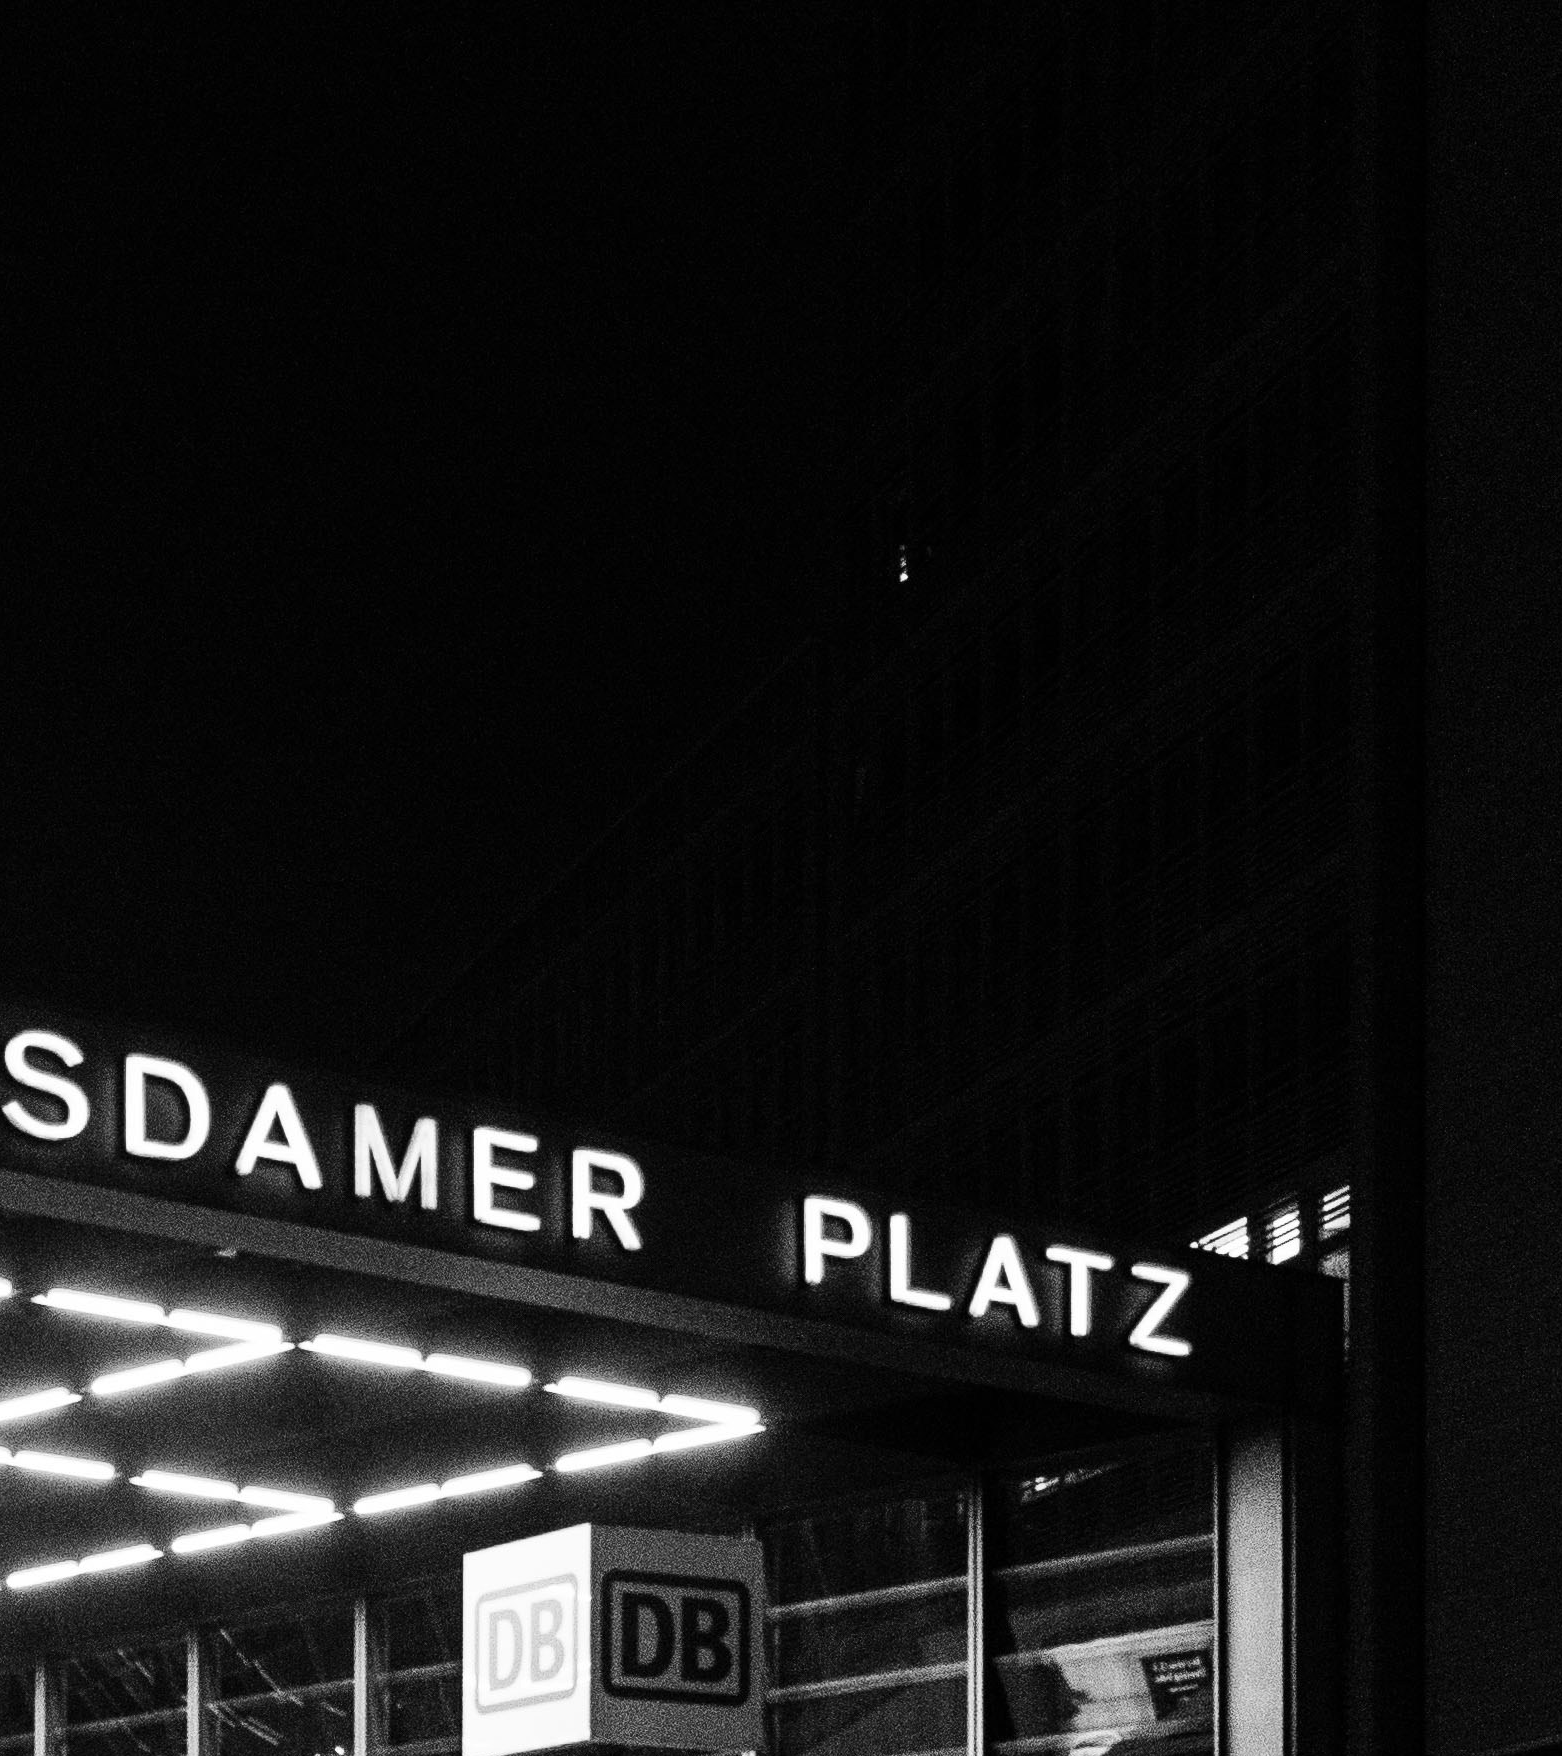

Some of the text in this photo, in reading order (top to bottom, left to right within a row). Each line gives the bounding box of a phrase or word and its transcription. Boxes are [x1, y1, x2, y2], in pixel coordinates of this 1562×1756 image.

[802, 1195, 1191, 1356] PLATZ
[489, 1600, 566, 1692] DB
[621, 1591, 733, 1683] DB
